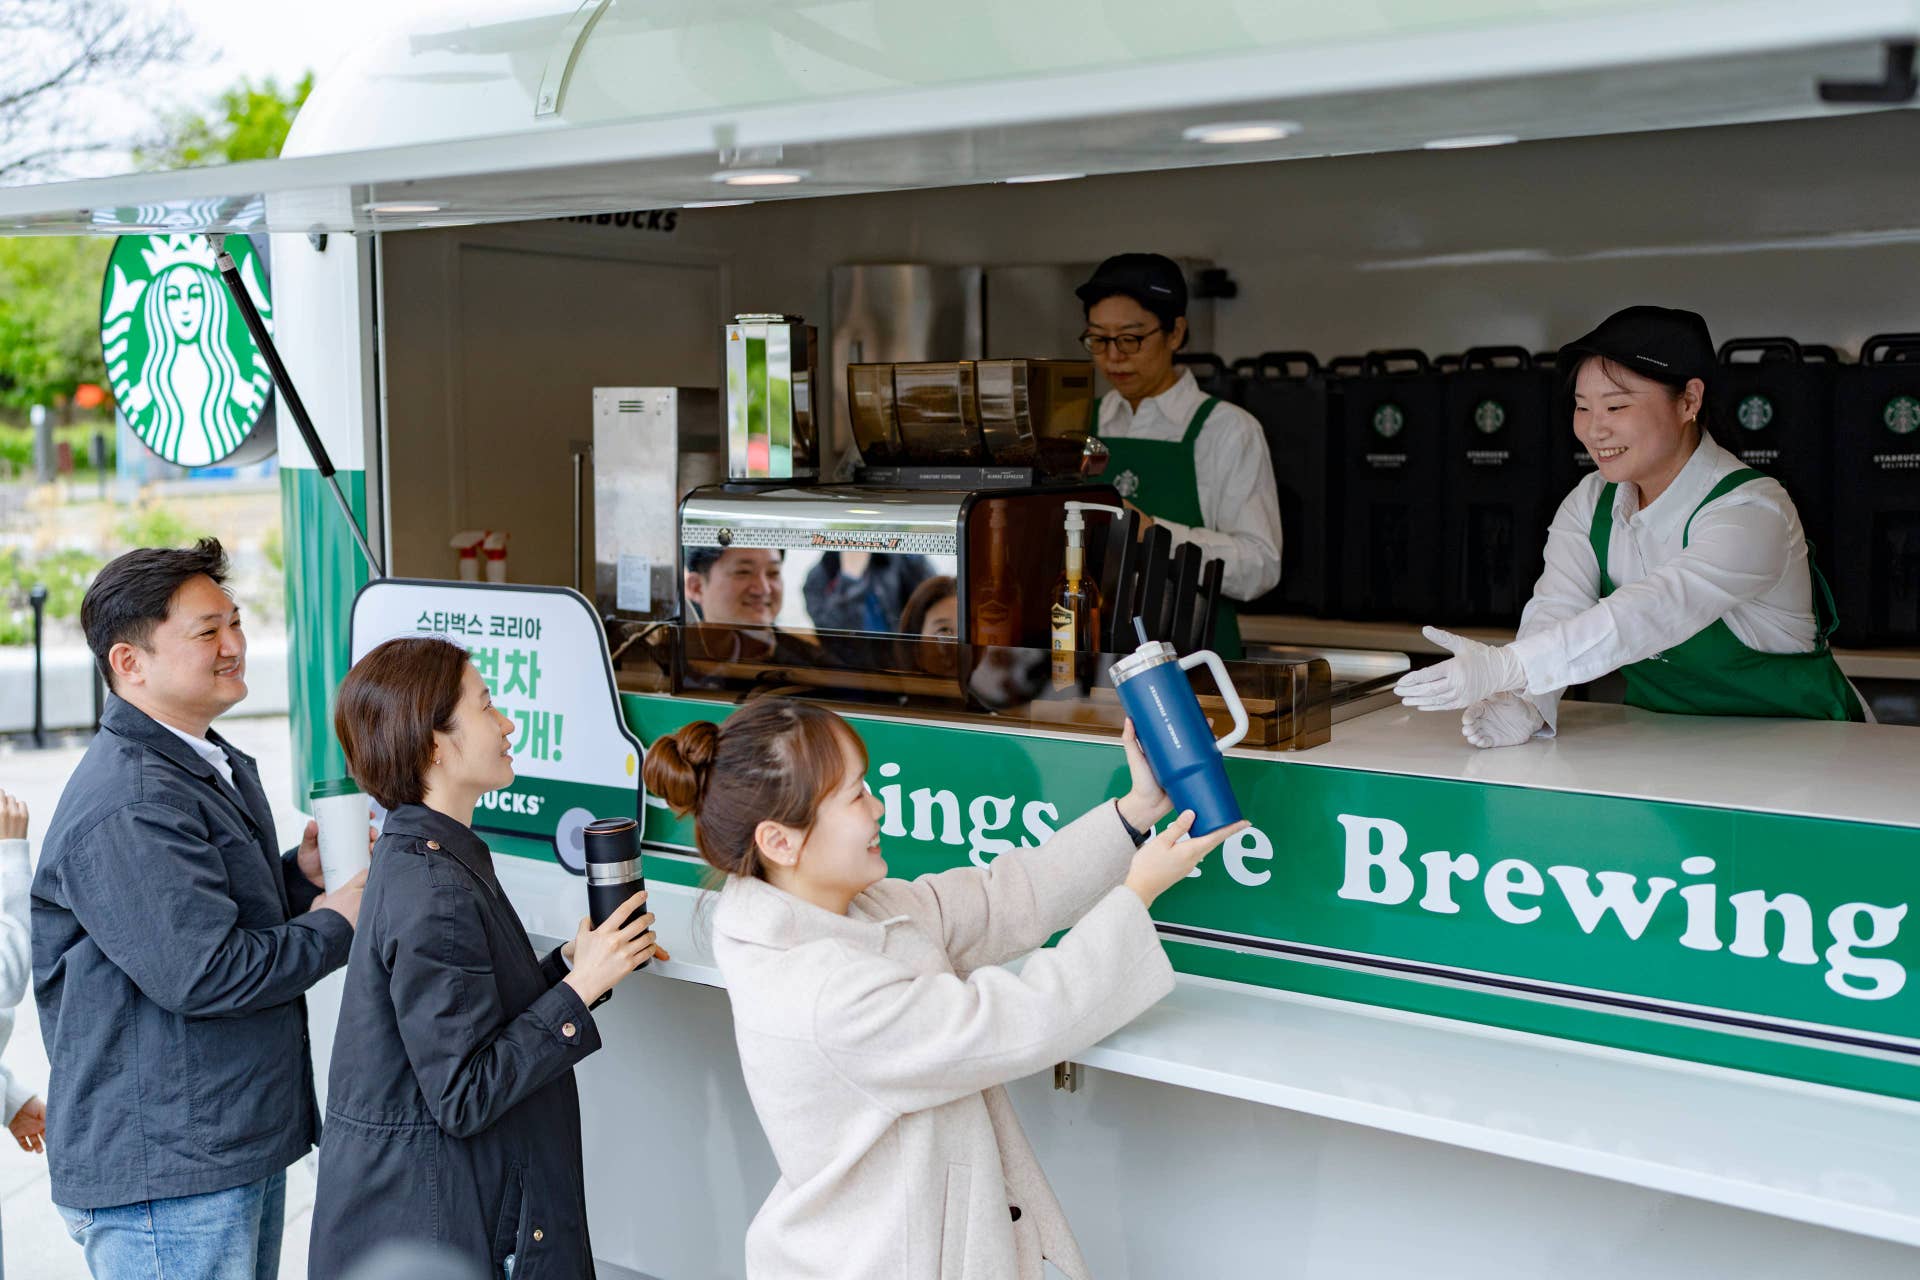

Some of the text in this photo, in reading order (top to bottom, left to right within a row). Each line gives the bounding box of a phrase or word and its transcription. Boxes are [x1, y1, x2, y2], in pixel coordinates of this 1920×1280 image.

[416, 611, 541, 640] 스타벅스 코리아
[497, 707, 564, 762] 개!
[863, 762, 1059, 869] ings
[1337, 813, 1908, 1000] Brewing
